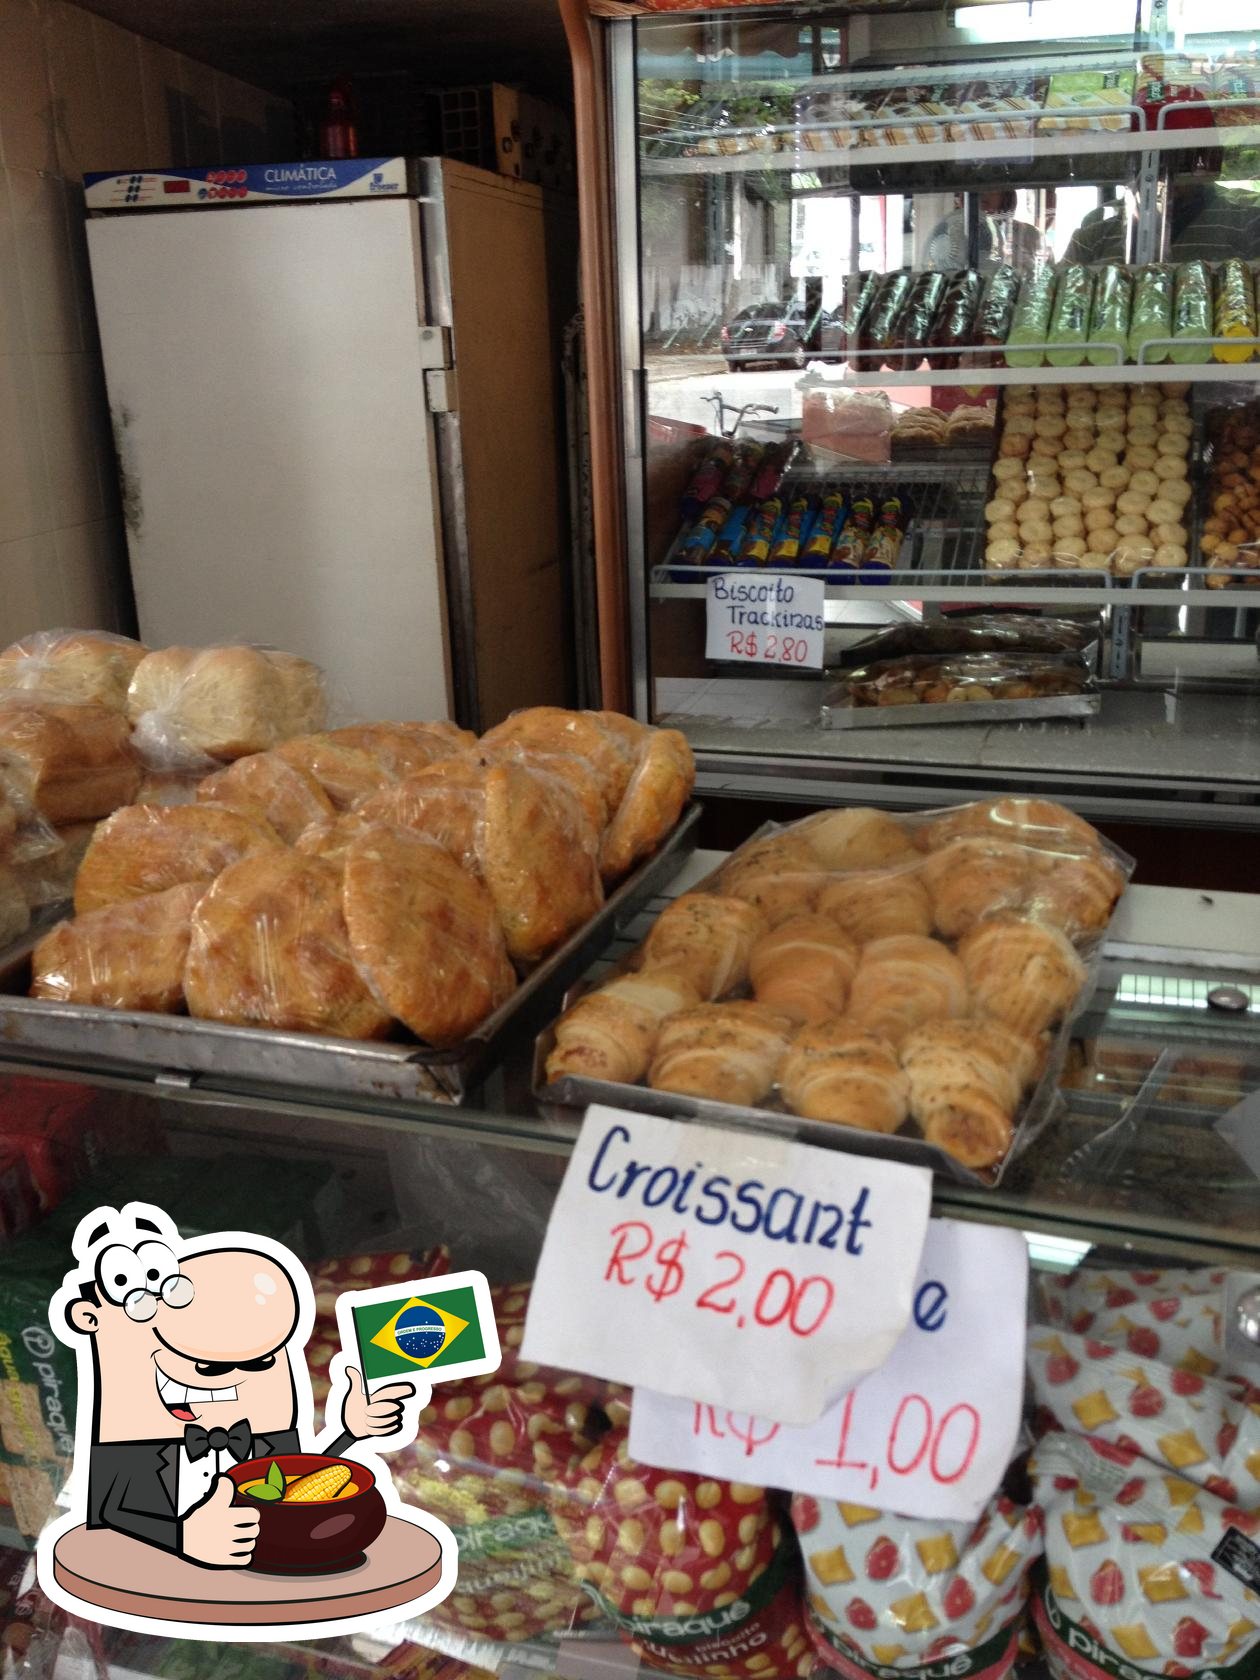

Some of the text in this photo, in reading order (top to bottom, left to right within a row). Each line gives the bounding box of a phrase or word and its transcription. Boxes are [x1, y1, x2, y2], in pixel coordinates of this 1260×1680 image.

[264, 165, 336, 183] CLIMÁTICA
[712, 577, 794, 603] Biscoito
[727, 605, 824, 631] Trackinas
[727, 630, 809, 663] R$ 2,80
[588, 1125, 872, 1256] Croissant
[605, 1220, 688, 1303] R$
[696, 1251, 835, 1338] 2,00
[814, 1388, 981, 1486] 1,00
